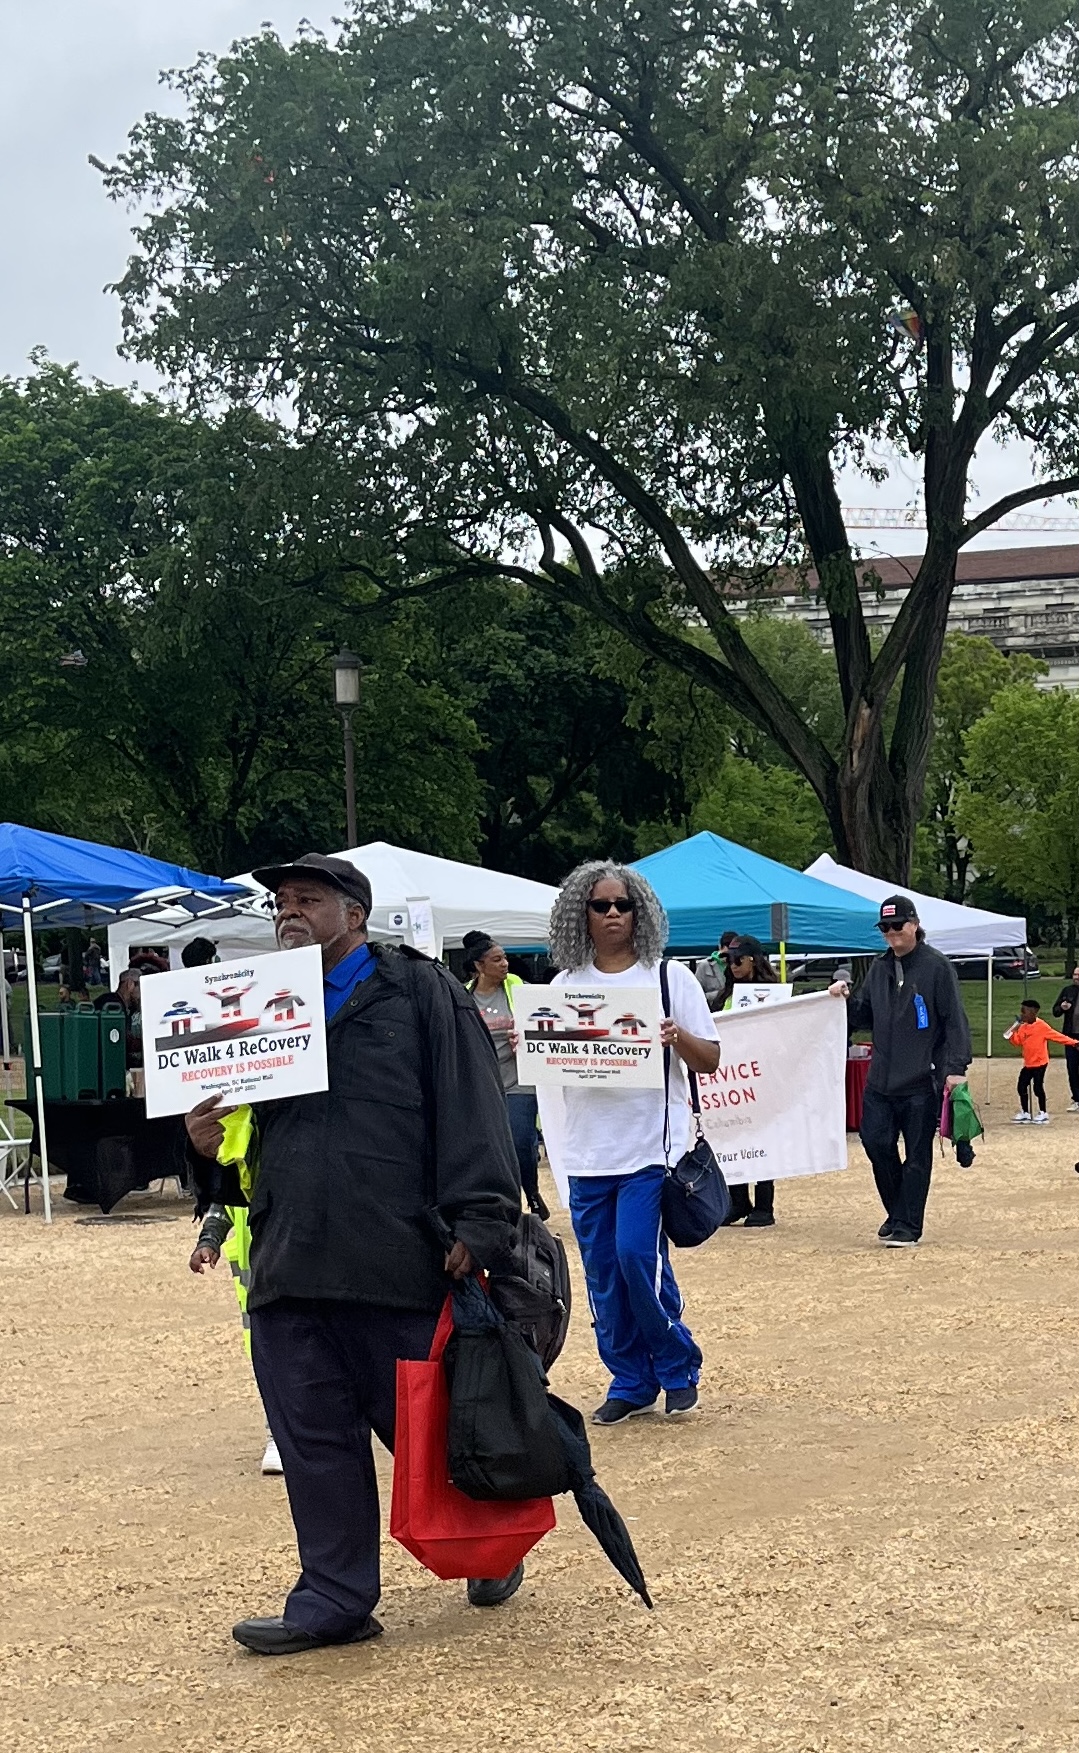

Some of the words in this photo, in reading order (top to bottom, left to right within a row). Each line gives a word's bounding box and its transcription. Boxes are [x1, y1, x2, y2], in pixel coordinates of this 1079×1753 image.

[205, 968, 255, 985] Synchronicity
[158, 1052, 179, 1070] DC
[184, 1045, 222, 1065] Walk
[226, 1043, 234, 1058] 4
[239, 1034, 311, 1057] ReCovery
[527, 1042, 544, 1053] DC
[548, 1042, 579, 1054] Walk
[582, 1044, 589, 1054] 4
[593, 1044, 651, 1058] ReCovery
[181, 1065, 233, 1082] RECOVERY
[236, 1063, 245, 1073] IS
[249, 1055, 294, 1071] POSSIBLE
[546, 1057, 588, 1066] RECOVERY
[590, 1057, 598, 1066] IS
[600, 1058, 638, 1067] POSSIBLE
[699, 1061, 761, 1087] ERVICE
[701, 1087, 756, 1110] SSION
[716, 1152, 738, 1163] Your
